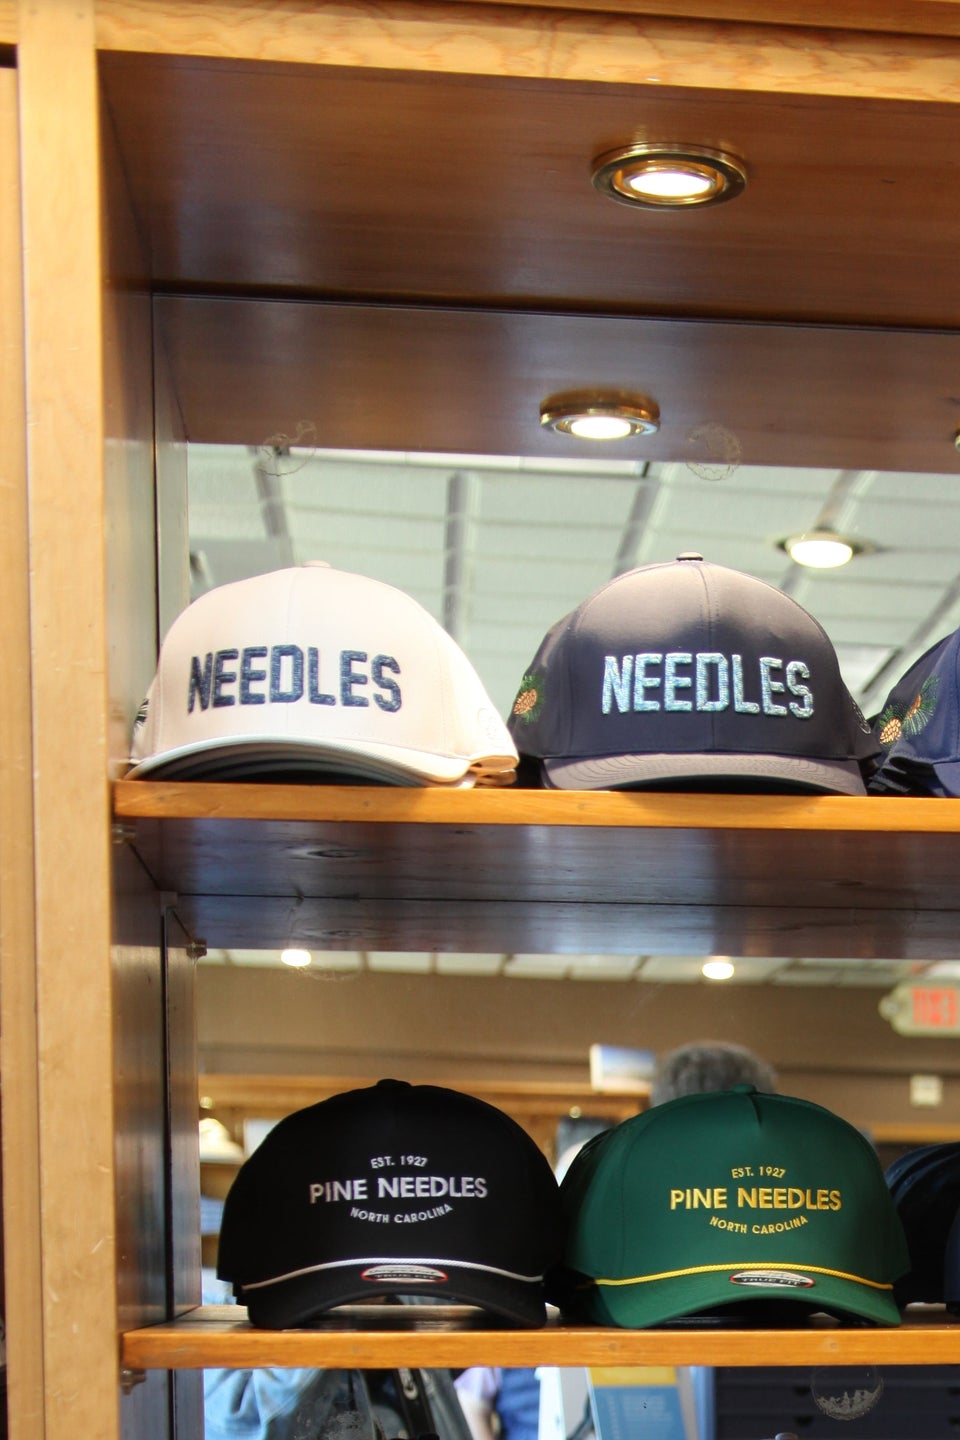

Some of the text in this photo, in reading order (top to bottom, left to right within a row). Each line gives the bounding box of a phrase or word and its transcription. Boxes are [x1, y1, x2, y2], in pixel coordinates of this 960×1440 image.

[187, 644, 402, 715] NEEDLES
[602, 653, 814, 719] NEEDLES
[370, 1155, 428, 1169] EST. 1927
[731, 1166, 786, 1179] EST. 1927
[309, 1176, 488, 1204] PINE NEEDLES
[670, 1187, 842, 1211] PINE NEEDLES
[350, 1203, 453, 1223] NORTH CAROLINA
[709, 1215, 808, 1234] NORTH CAROLINA
